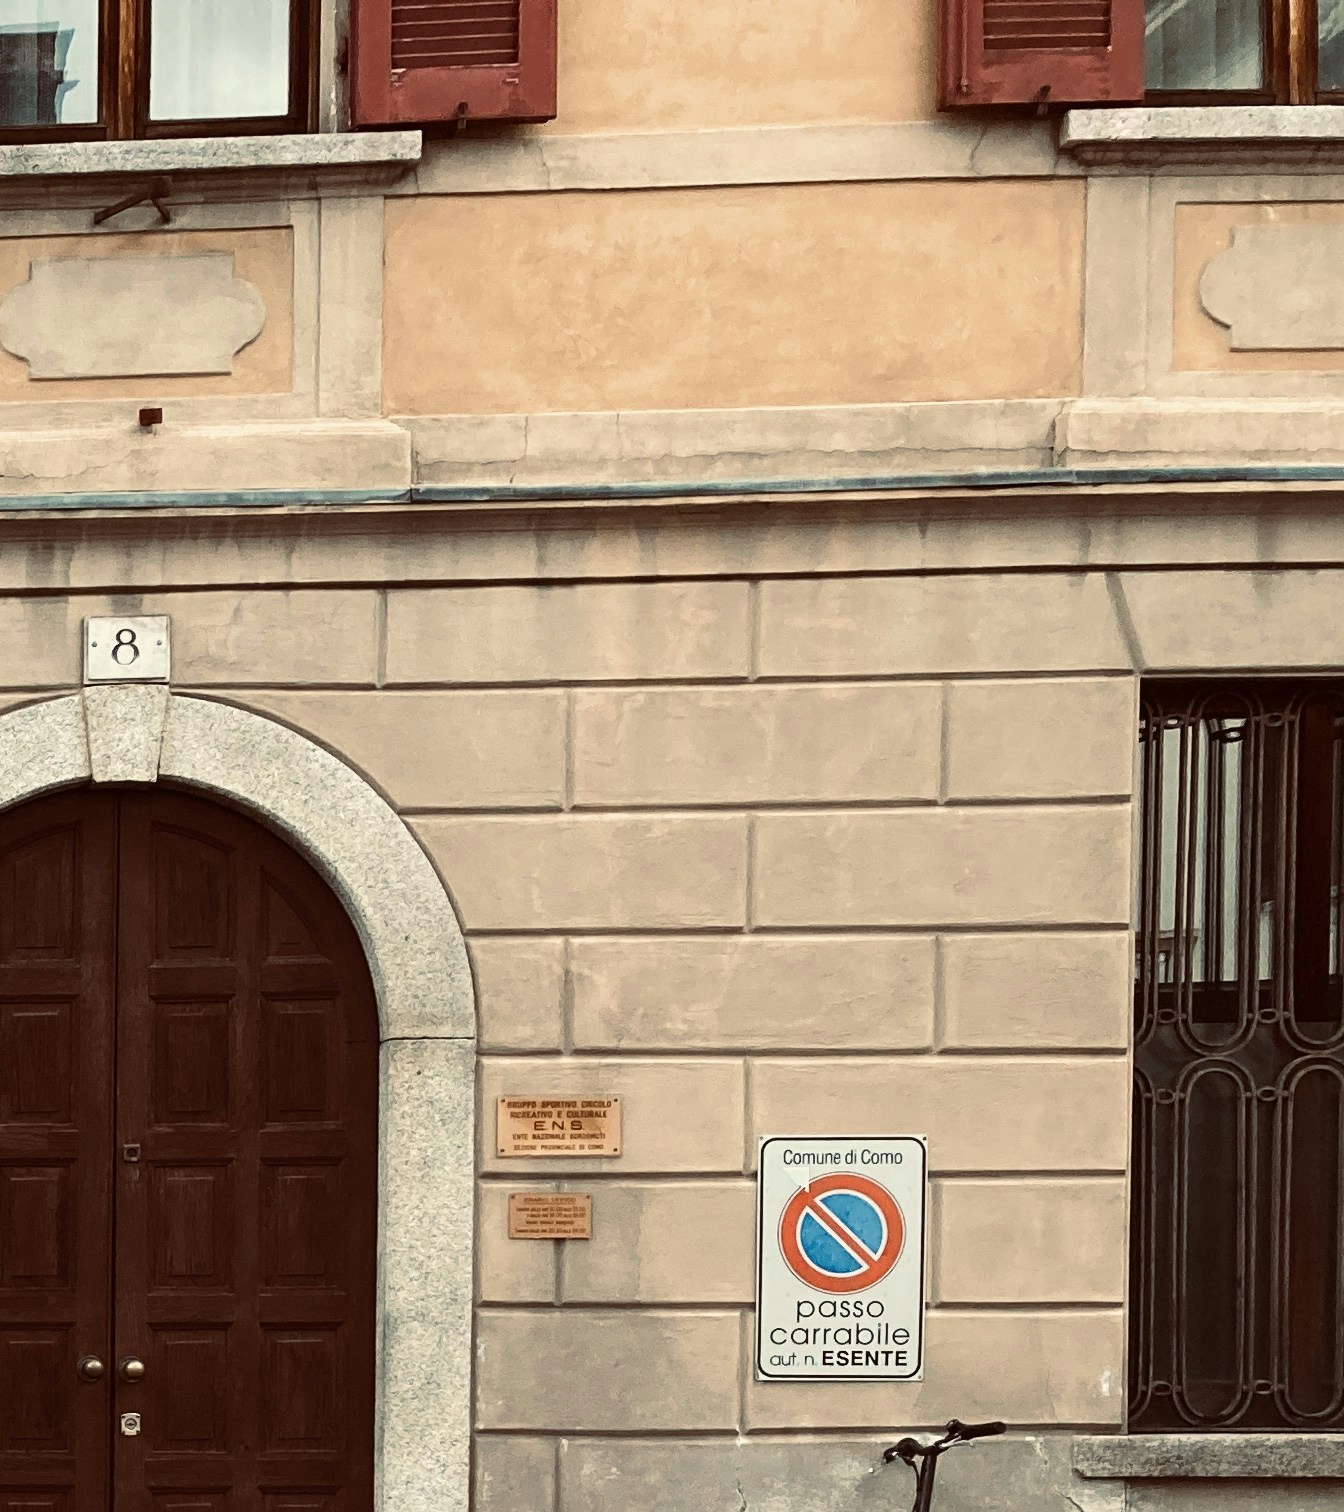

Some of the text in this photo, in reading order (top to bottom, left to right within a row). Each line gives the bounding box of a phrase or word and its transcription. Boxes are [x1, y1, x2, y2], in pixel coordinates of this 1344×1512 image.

[111, 628, 140, 666] 8
[557, 1110, 563, 1118] E
[783, 1149, 903, 1165] Comune di Como
[797, 1300, 885, 1324] passo
[769, 1323, 910, 1346] carrabile
[769, 1352, 800, 1366] aut.
[822, 1350, 908, 1366] ESENTE
